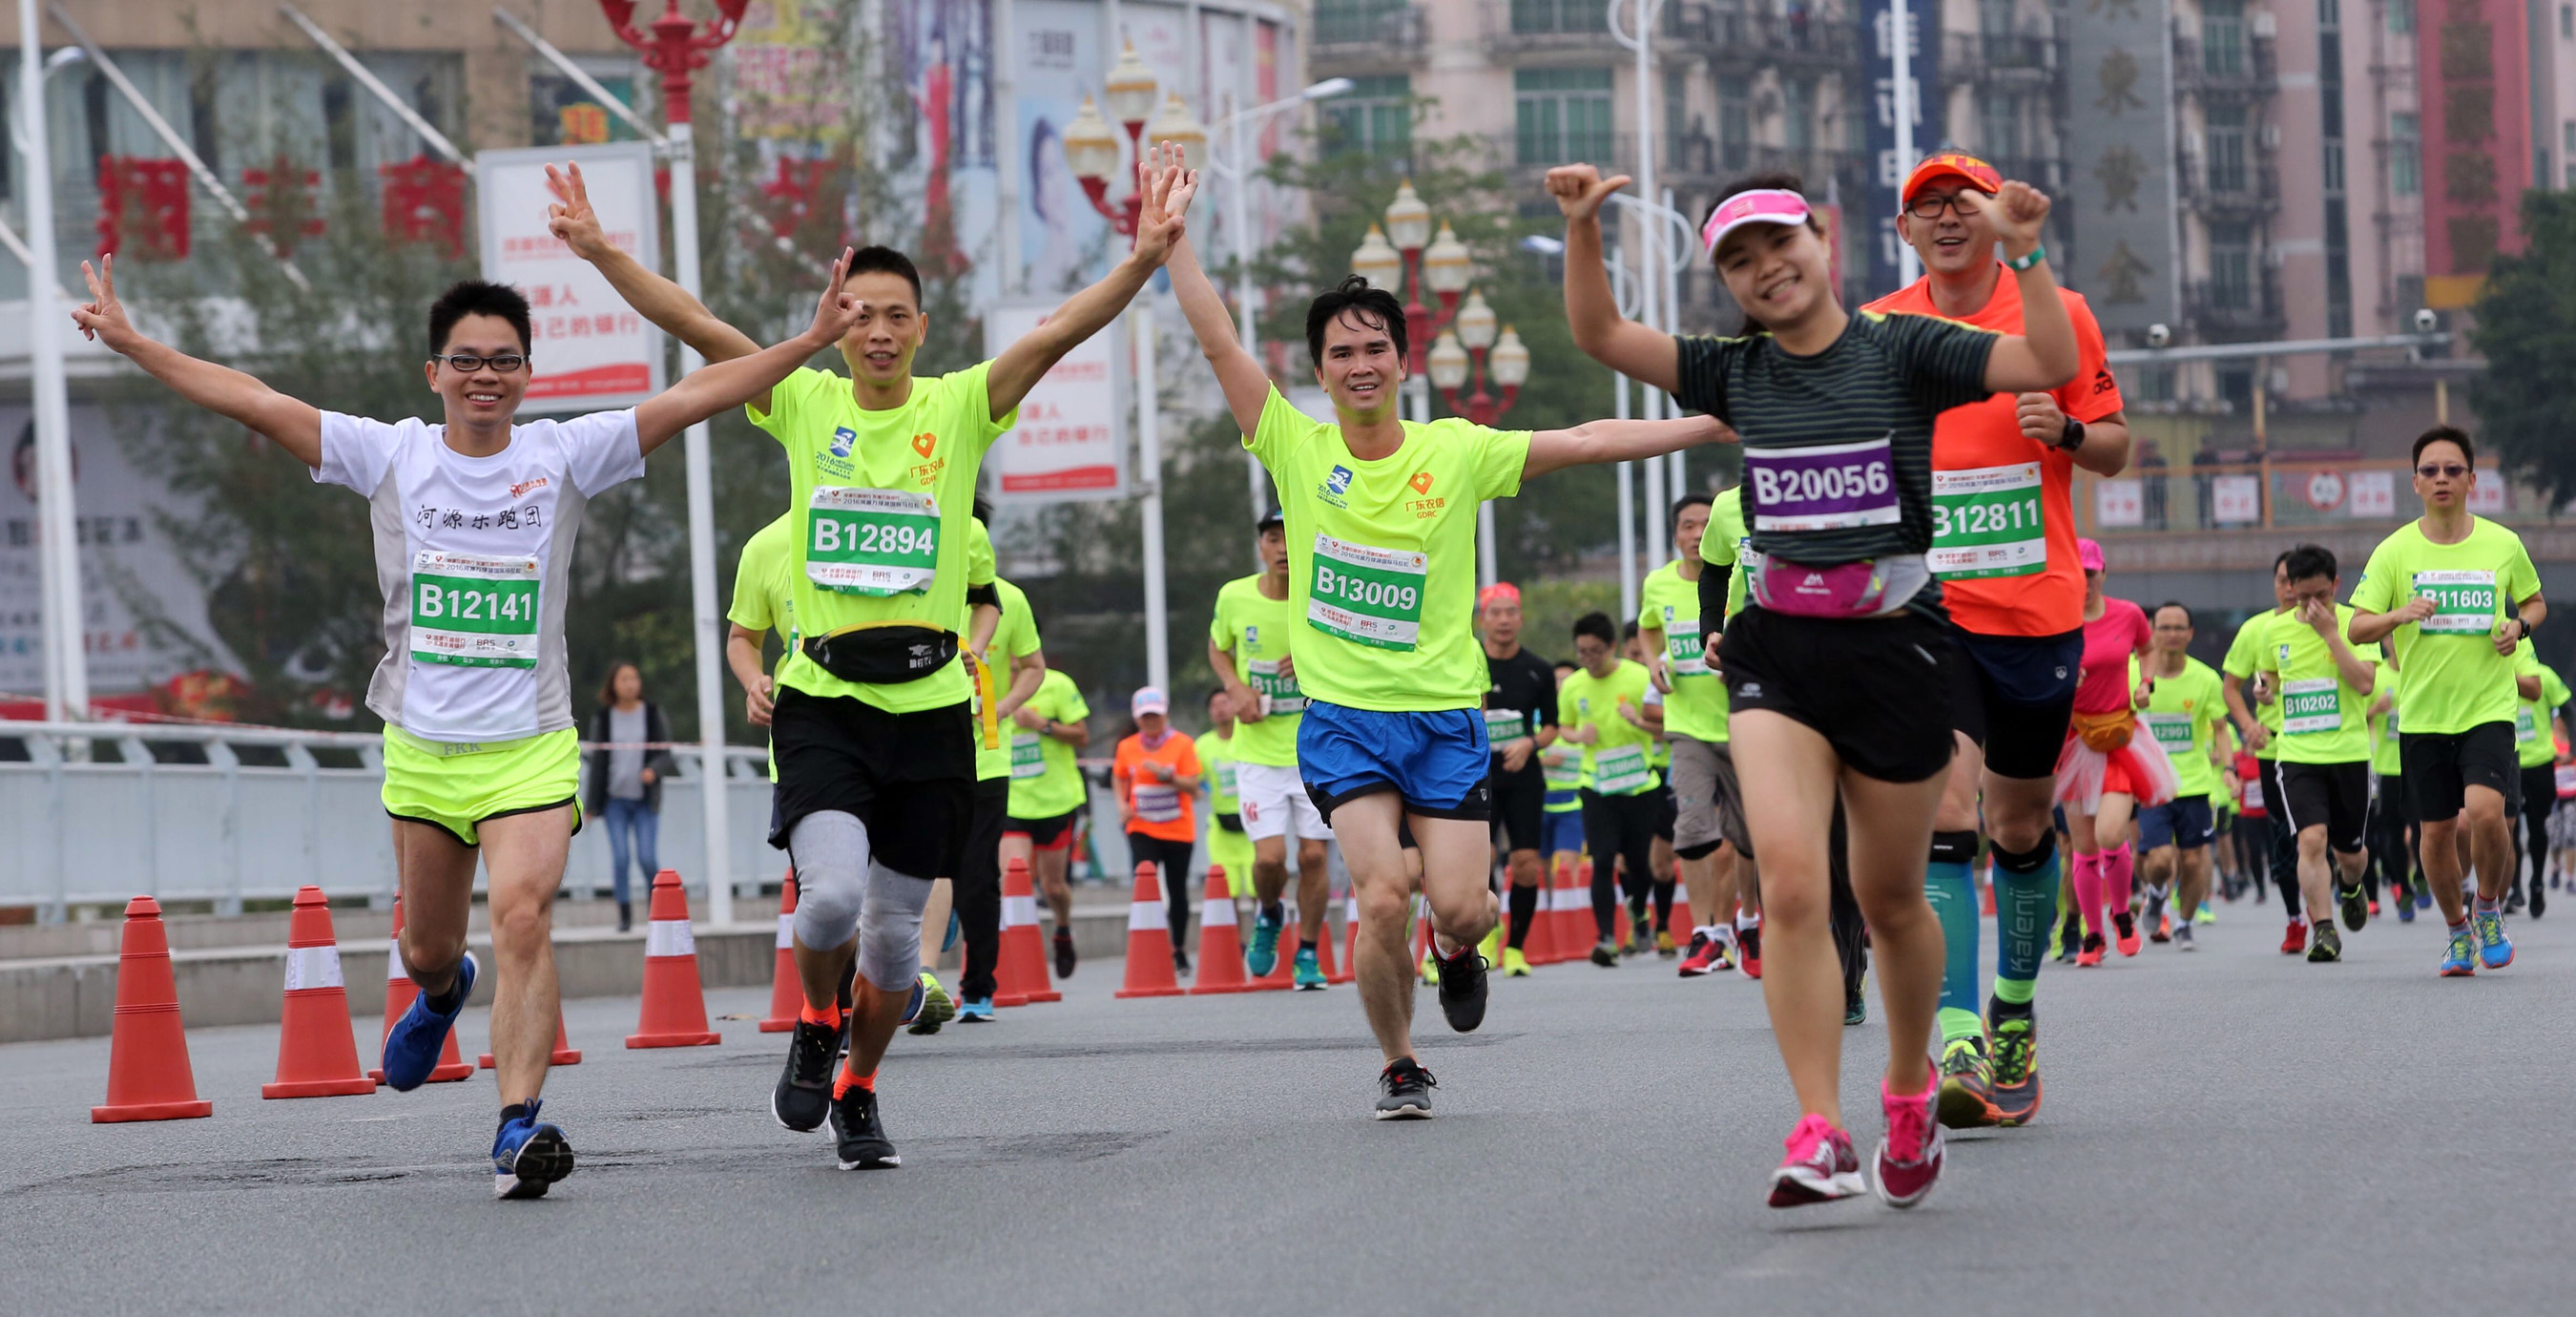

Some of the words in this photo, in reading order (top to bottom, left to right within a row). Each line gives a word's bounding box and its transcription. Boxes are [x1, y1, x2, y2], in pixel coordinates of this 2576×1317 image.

[1752, 461, 1889, 506] B20056
[417, 504, 542, 531] 河源乐跑团
[1405, 497, 1445, 512] 广东农信
[1417, 511, 1438, 519] GDRC
[1932, 498, 2038, 537] B12811
[815, 518, 934, 555] B12894
[1318, 565, 1417, 611] B13009
[2421, 589, 2492, 608] B11603
[420, 583, 531, 621] B12141
[1361, 619, 1378, 629] BRS
[2285, 694, 2337, 715] B10202
